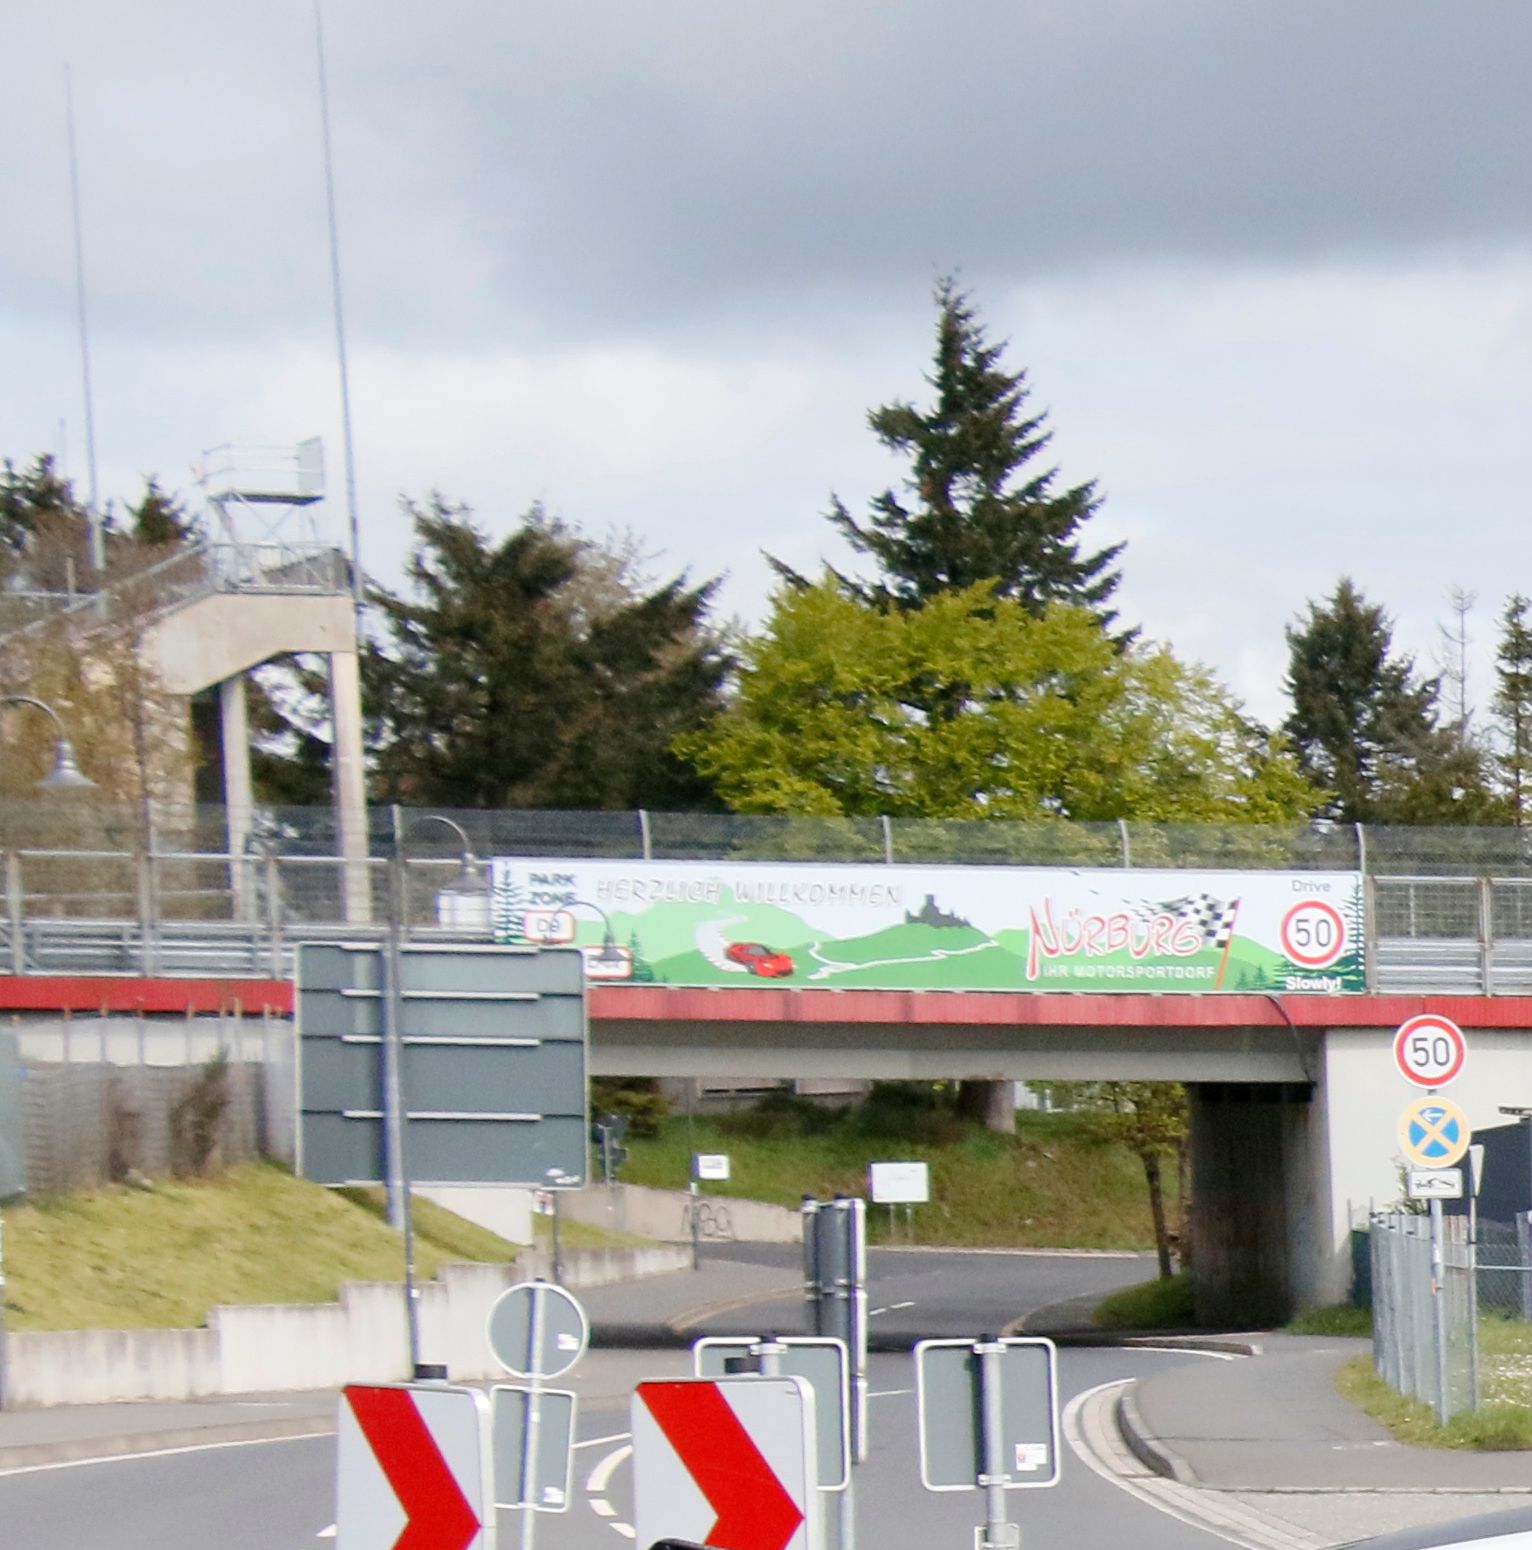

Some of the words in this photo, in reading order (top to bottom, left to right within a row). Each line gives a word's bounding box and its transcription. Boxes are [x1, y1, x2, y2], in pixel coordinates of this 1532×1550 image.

[529, 873, 575, 886] PARK
[1291, 880, 1332, 892] Drive
[529, 892, 575, 905] ZONE
[596, 879, 720, 903] HERZLICH
[735, 881, 900, 905] WILLKOMMEN
[1026, 897, 1201, 981] NÜRBURG
[1295, 919, 1332, 947] 50
[1044, 965, 1068, 978] IHR
[1074, 965, 1216, 979] MOTORSPORTDORF
[1286, 976, 1342, 993] Slowly!
[1412, 1037, 1450, 1067] 50
